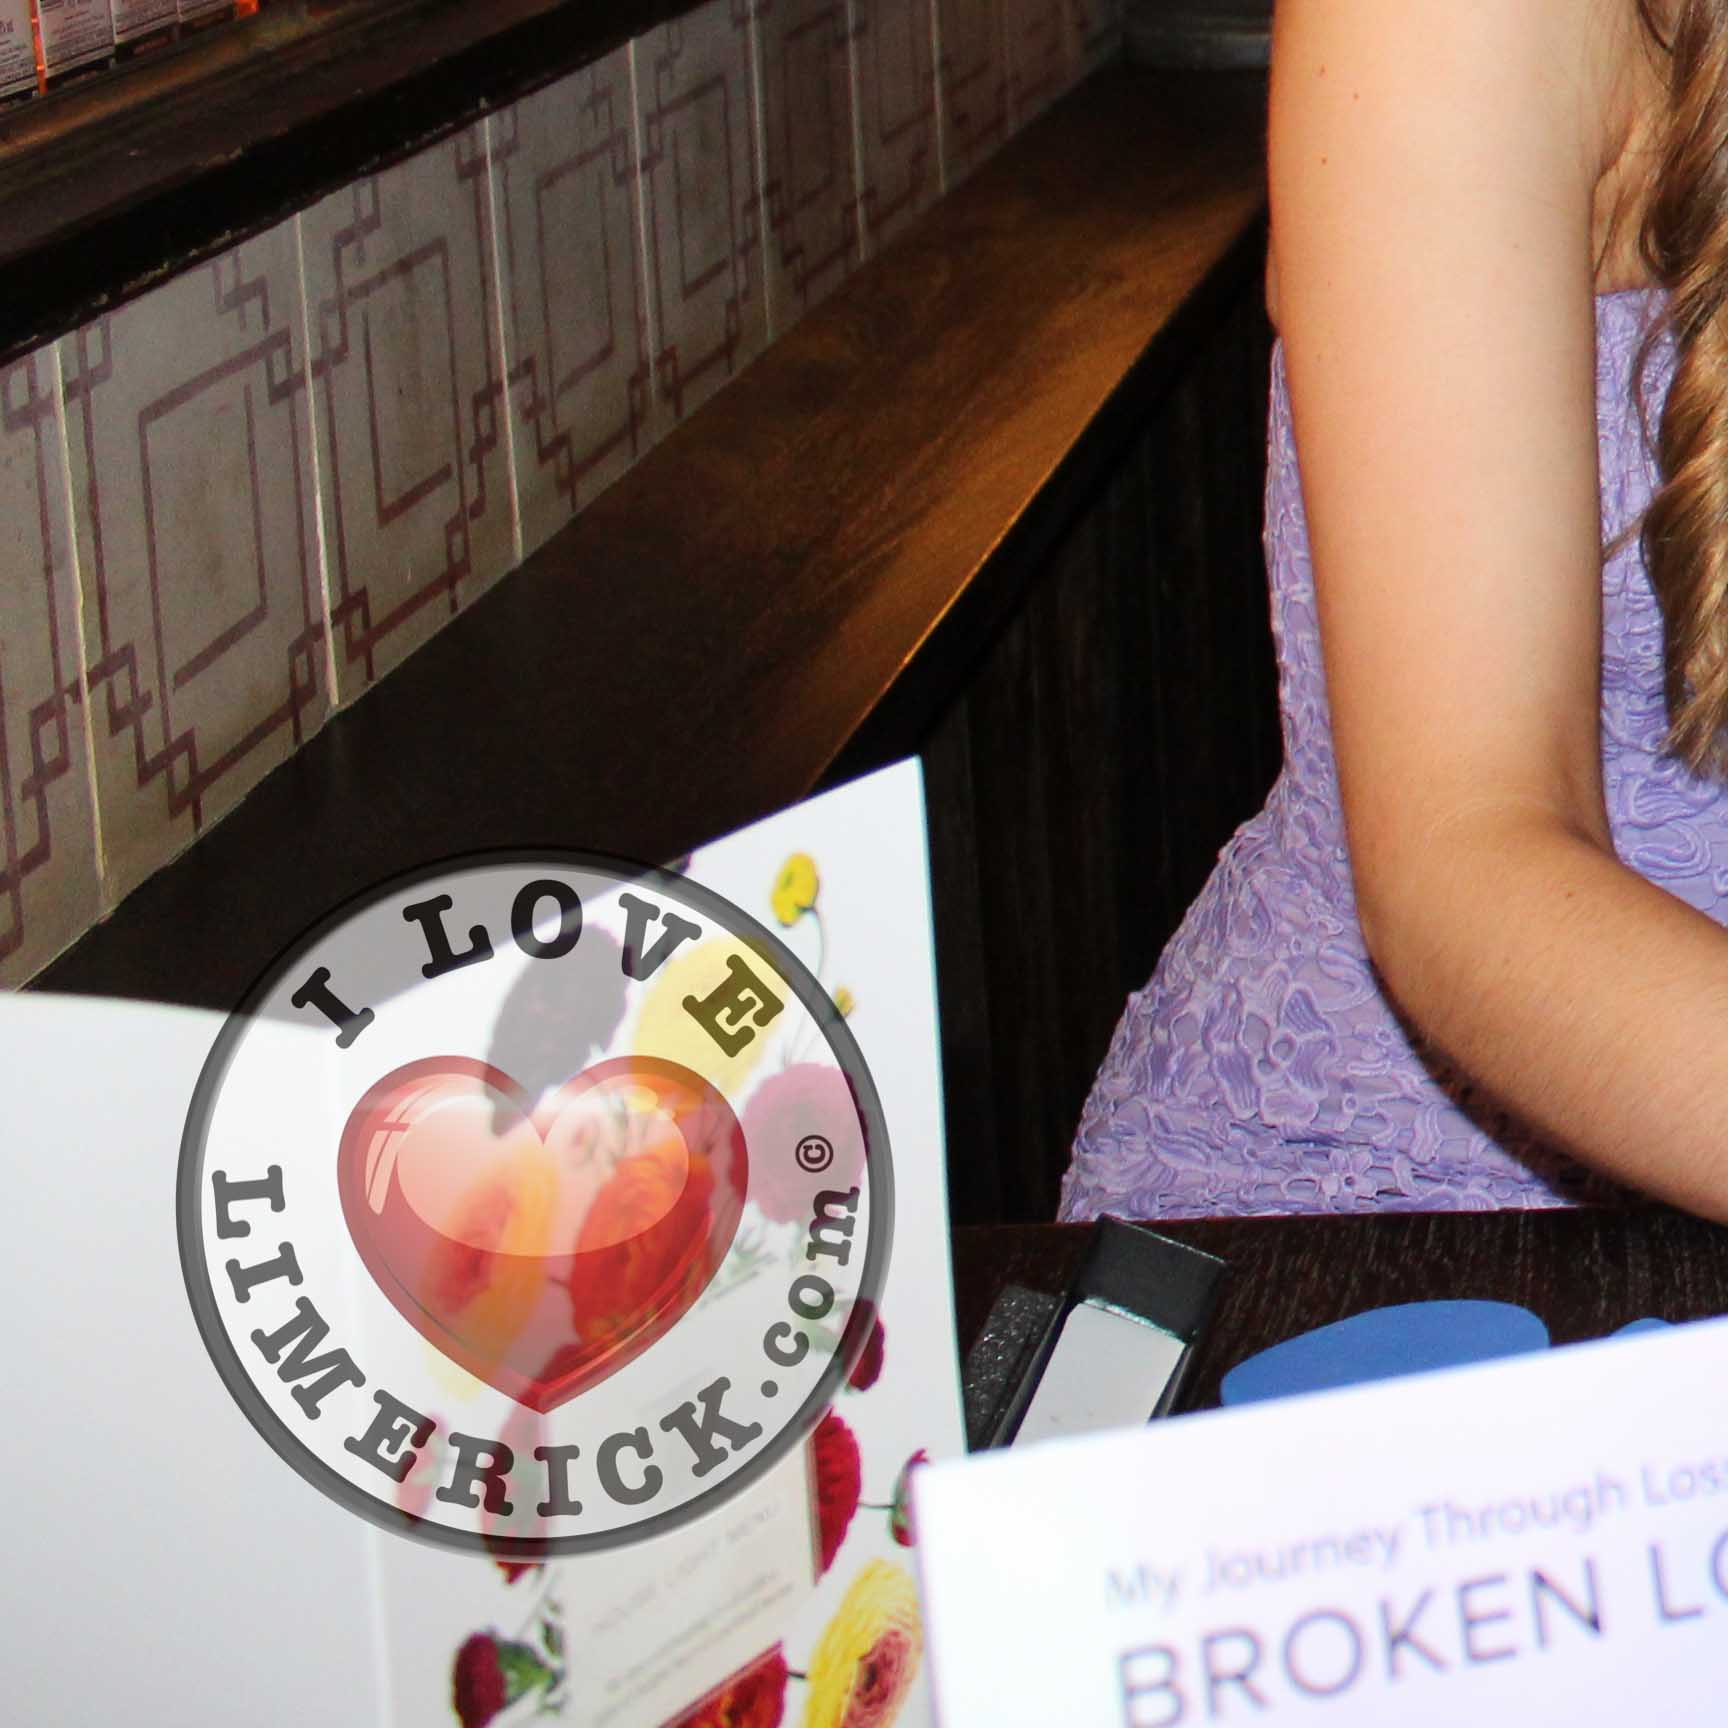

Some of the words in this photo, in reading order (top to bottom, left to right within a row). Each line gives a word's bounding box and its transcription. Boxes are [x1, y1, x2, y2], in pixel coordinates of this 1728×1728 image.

[1104, 1563, 1184, 1616] My
[1200, 1522, 1404, 1597] Journey
[1419, 1472, 1626, 1551] Through
[1117, 1556, 1604, 1728] BROKEN
